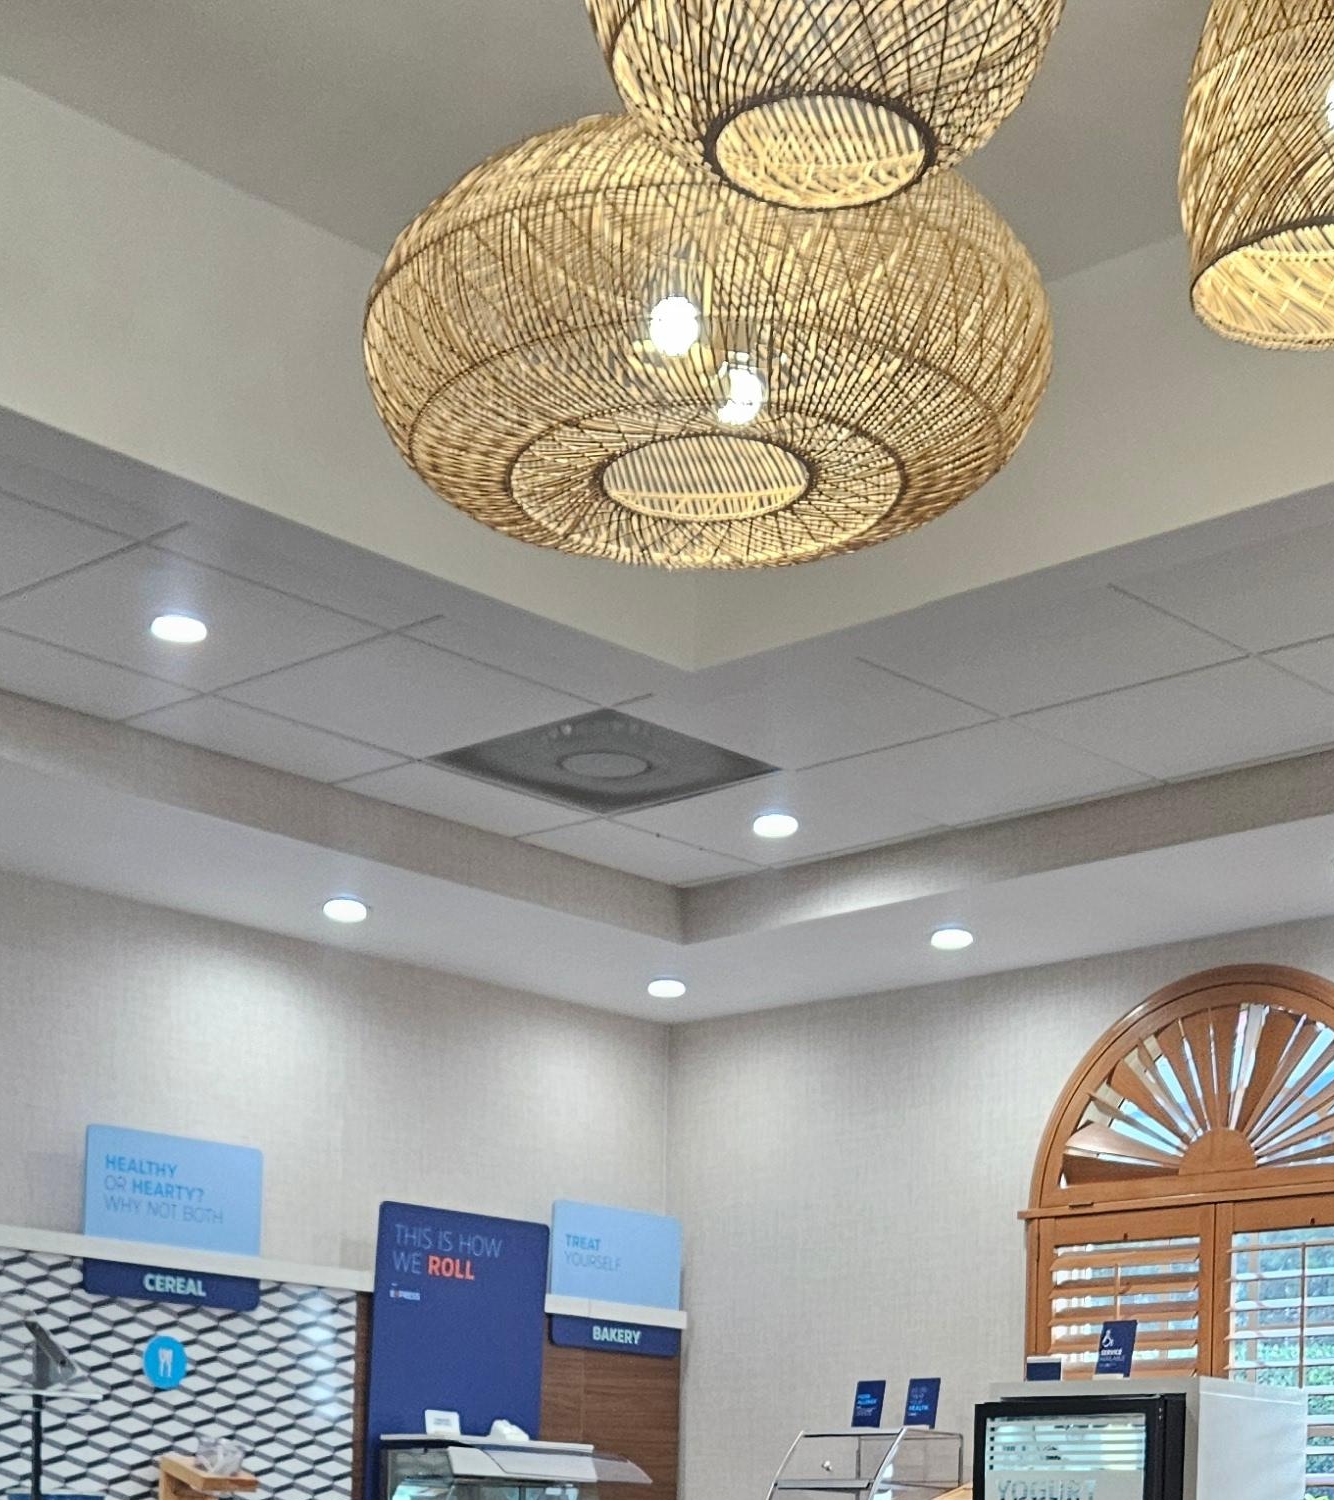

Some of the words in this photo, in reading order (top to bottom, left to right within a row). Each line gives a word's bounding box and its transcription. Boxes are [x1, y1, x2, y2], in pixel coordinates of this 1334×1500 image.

[105, 1154, 178, 1178] HEALTHY
[104, 1174, 127, 1191] OR
[132, 1180, 205, 1203] HEARTY?
[104, 1194, 141, 1213] WHY
[147, 1202, 178, 1219] NOT
[182, 1206, 224, 1224] BOTH
[395, 1223, 433, 1249] THIS
[438, 1231, 453, 1252] IS
[458, 1233, 503, 1258] HOW
[565, 1234, 602, 1251] TREAT
[392, 1250, 422, 1275] WE
[428, 1254, 475, 1280] ROLL
[564, 1251, 622, 1271] YOURSELF
[143, 1272, 207, 1297] CEREAL
[592, 1325, 642, 1345] BAKERY
